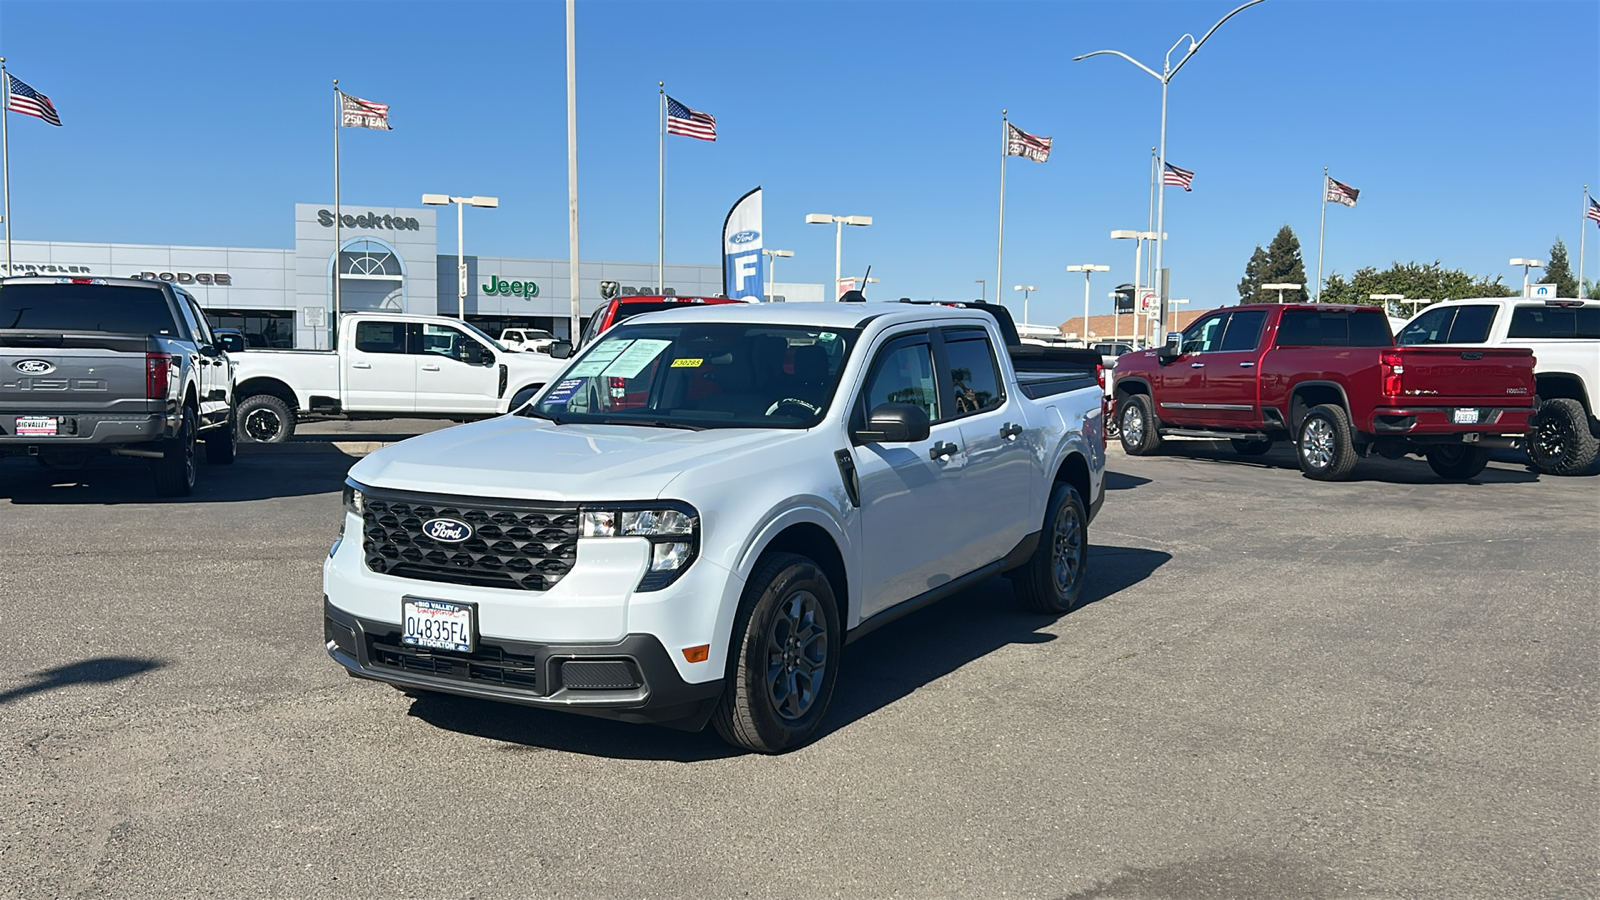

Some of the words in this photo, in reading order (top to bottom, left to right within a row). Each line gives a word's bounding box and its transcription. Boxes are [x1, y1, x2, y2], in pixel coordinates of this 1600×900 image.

[344, 114, 363, 124] 250
[317, 209, 419, 231] Stockton
[734, 231, 755, 244] Ford
[1, 264, 91, 274] CHRYSLER
[141, 271, 232, 286] DODGE
[482, 275, 540, 301] Jeep
[0, 378, 108, 392] -150
[431, 521, 463, 540] Ford
[430, 602, 454, 612] VALLEY
[407, 616, 468, 644] 04835F4
[418, 639, 456, 651] STOCKTON
